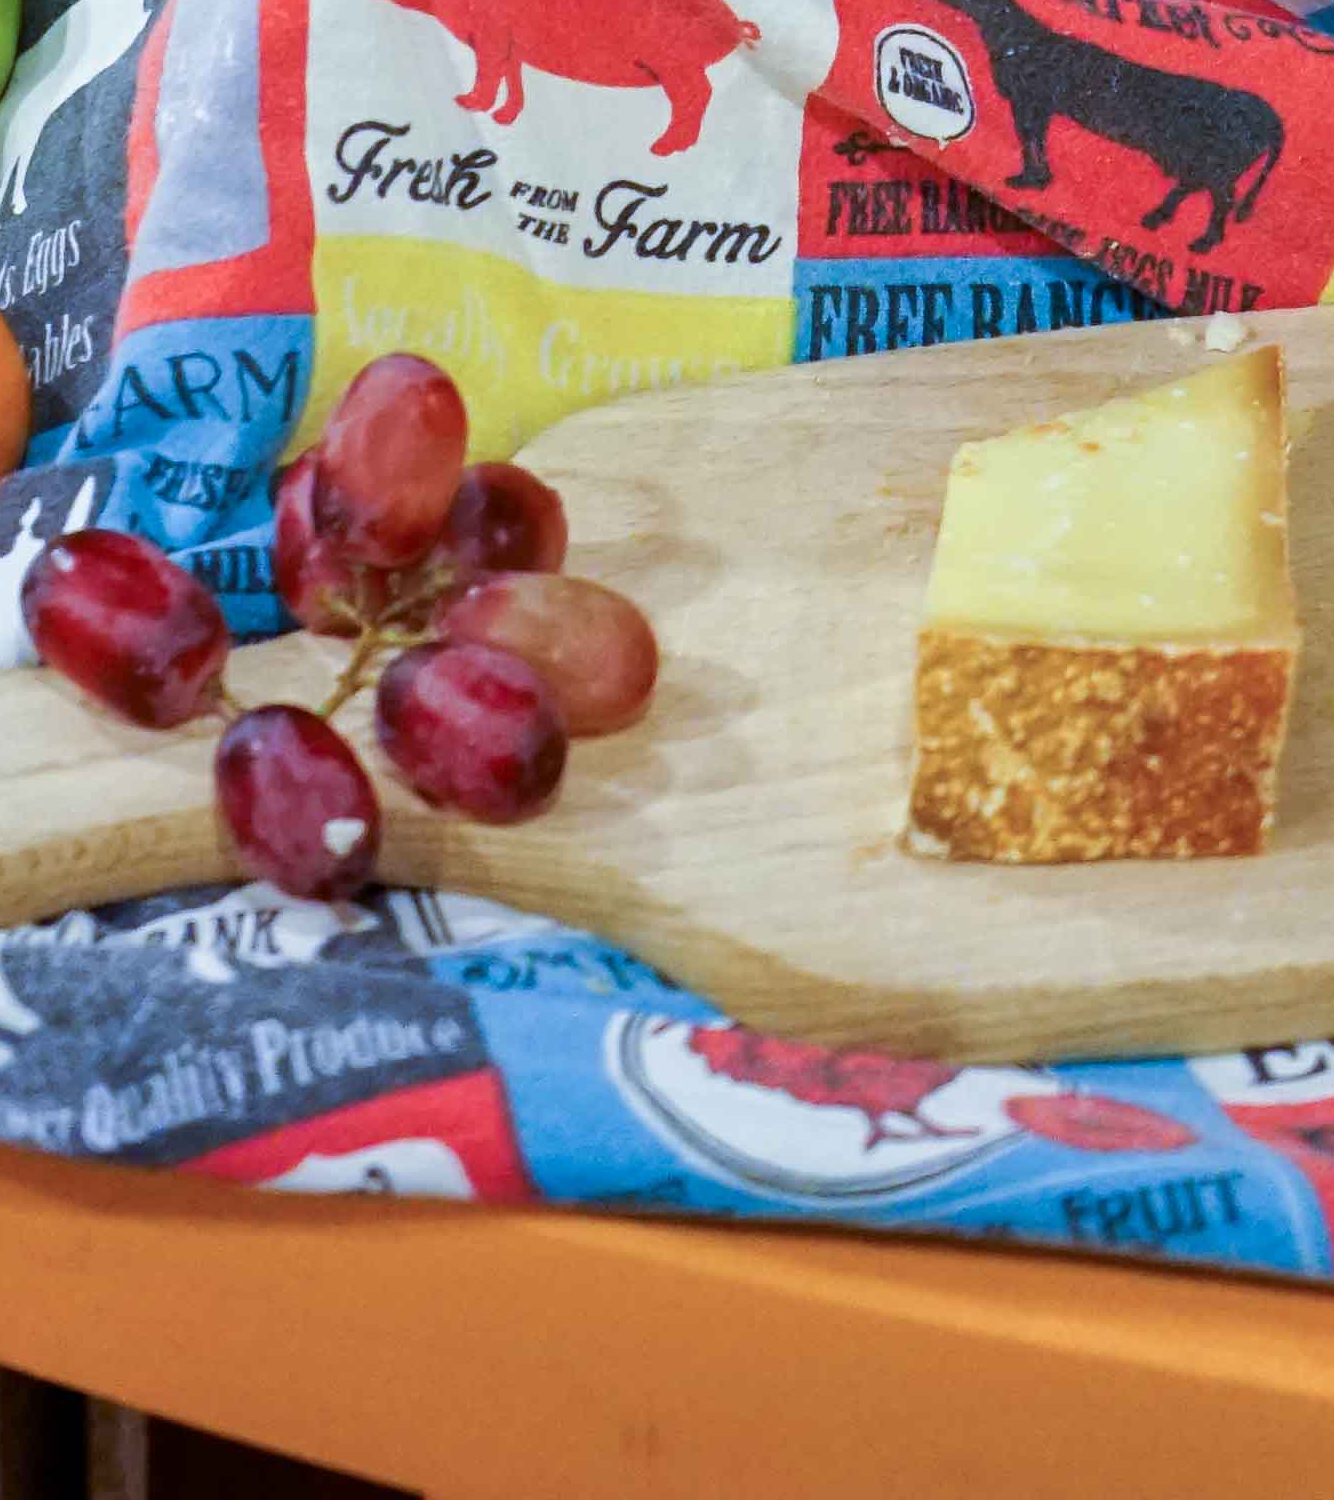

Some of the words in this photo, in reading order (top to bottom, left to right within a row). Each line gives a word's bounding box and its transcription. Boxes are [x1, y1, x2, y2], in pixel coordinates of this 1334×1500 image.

[326, 119, 499, 209] Fresh
[510, 180, 579, 213] FROM
[22, 216, 81, 298] Eggs
[516, 211, 572, 246] THE
[583, 179, 782, 267] Farm
[809, 284, 955, 363] FREE
